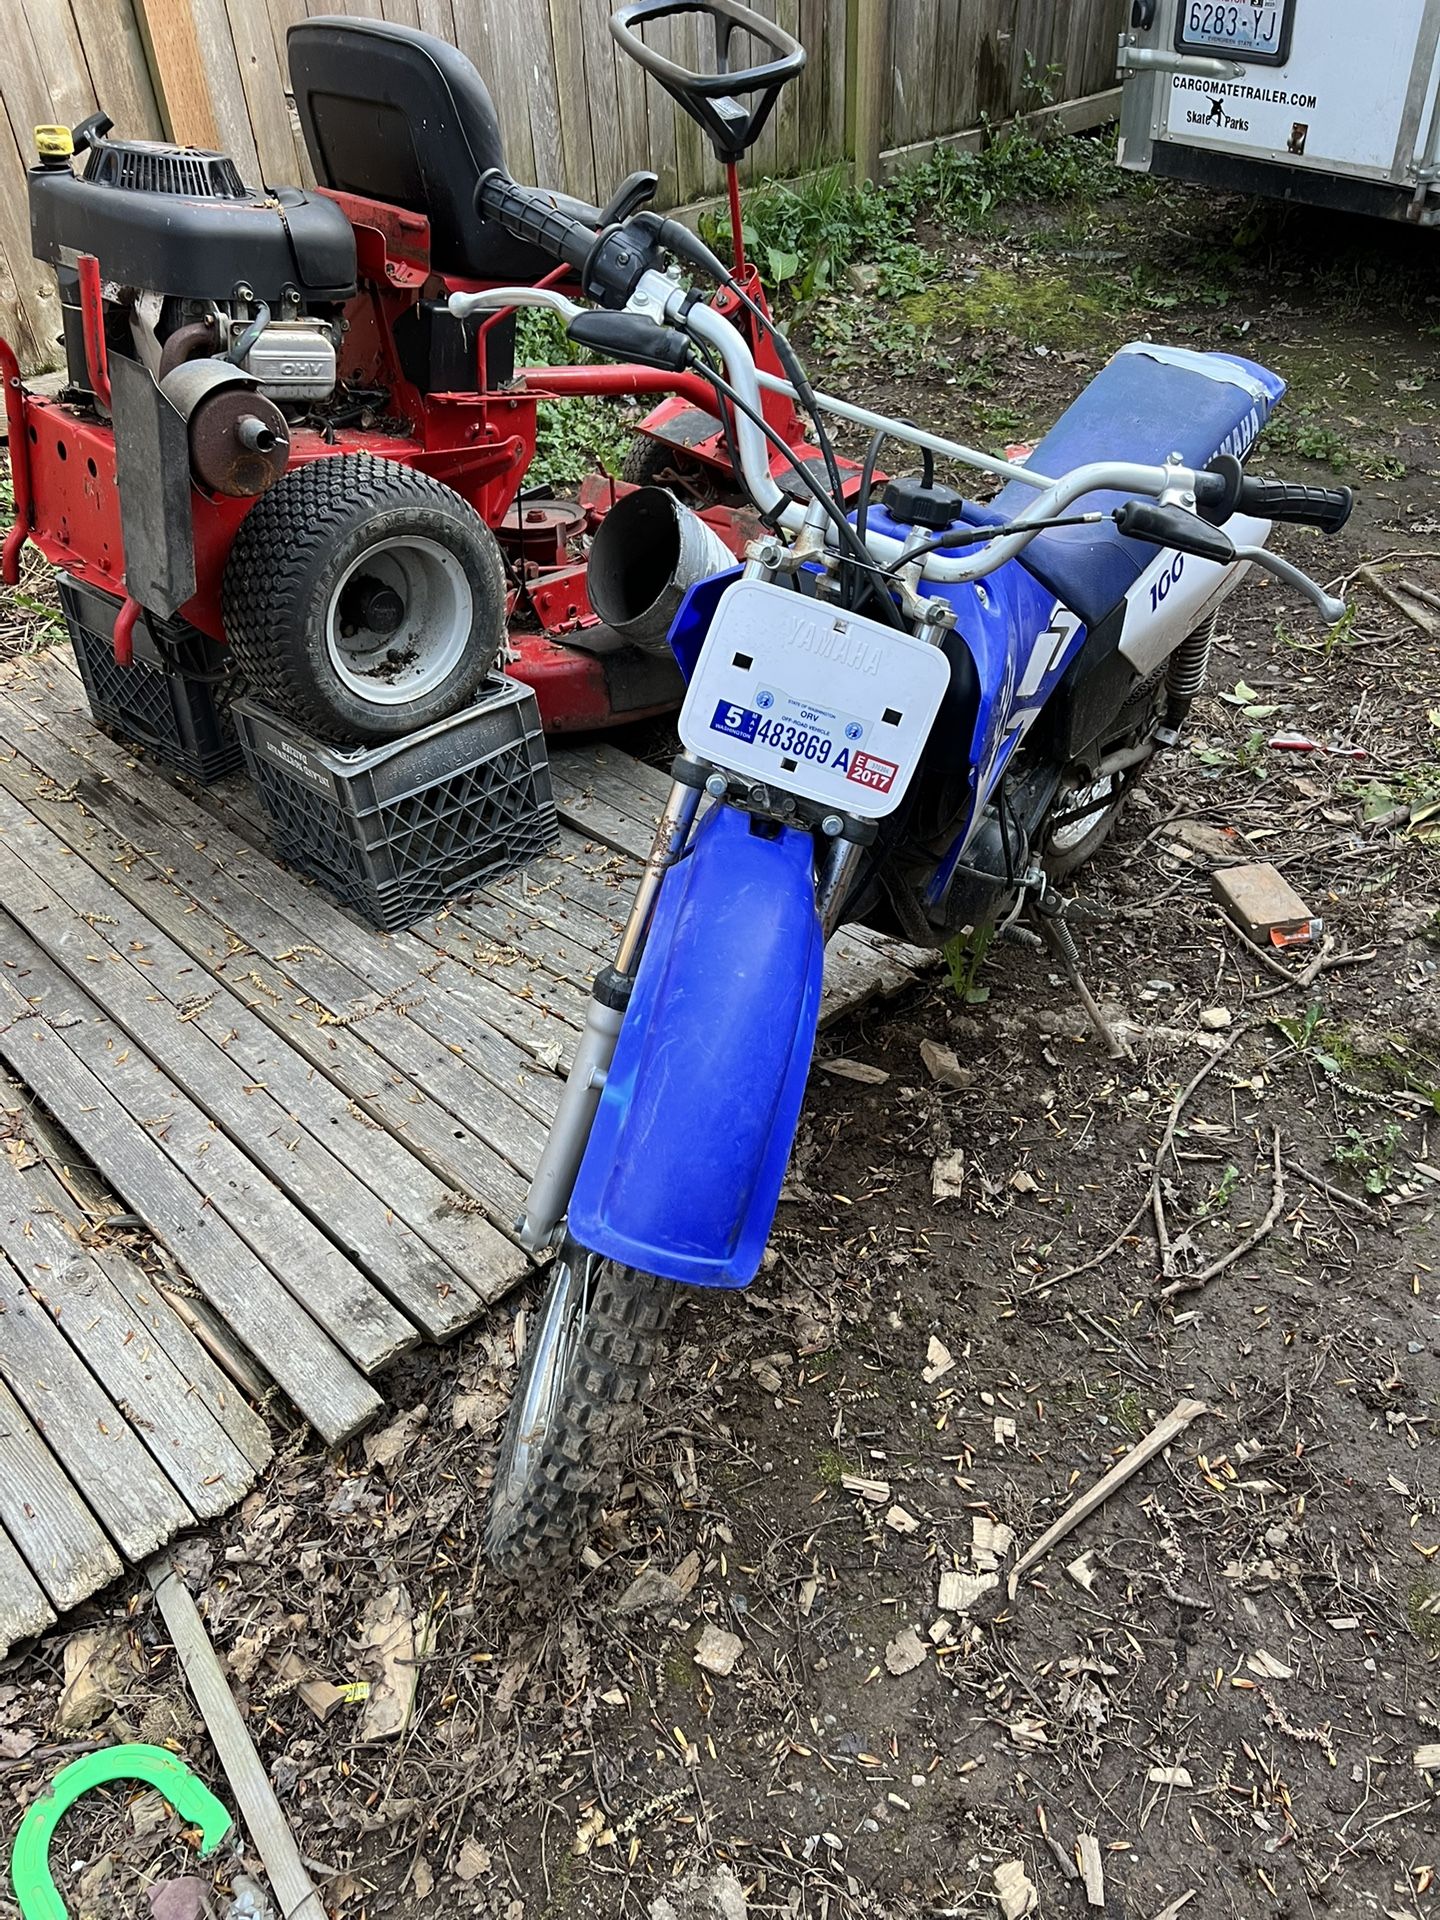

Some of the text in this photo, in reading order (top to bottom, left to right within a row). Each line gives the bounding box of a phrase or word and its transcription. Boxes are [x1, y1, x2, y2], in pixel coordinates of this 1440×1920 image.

[1190, 3, 1276, 41] 6283-YJ
[1173, 76, 1317, 109] CARGOMATETRAILER.COM
[1186, 110, 1249, 132] Skate Parks
[281, 362, 323, 376] OHV
[1150, 551, 1184, 613] 100
[788, 616, 884, 676] YAMAHA
[787, 699, 800, 707] STATE
[724, 706, 744, 728] 5
[748, 712, 758, 733] MAY
[781, 715, 831, 736] OFF-ROAD VEHICLE
[800, 710, 819, 722] ORV
[715, 723, 751, 739] WASHINGTON
[758, 719, 850, 773] 483869 A
[414, 744, 487, 784] WARNING
[855, 755, 866, 767] E
[851, 767, 890, 789] 2017
